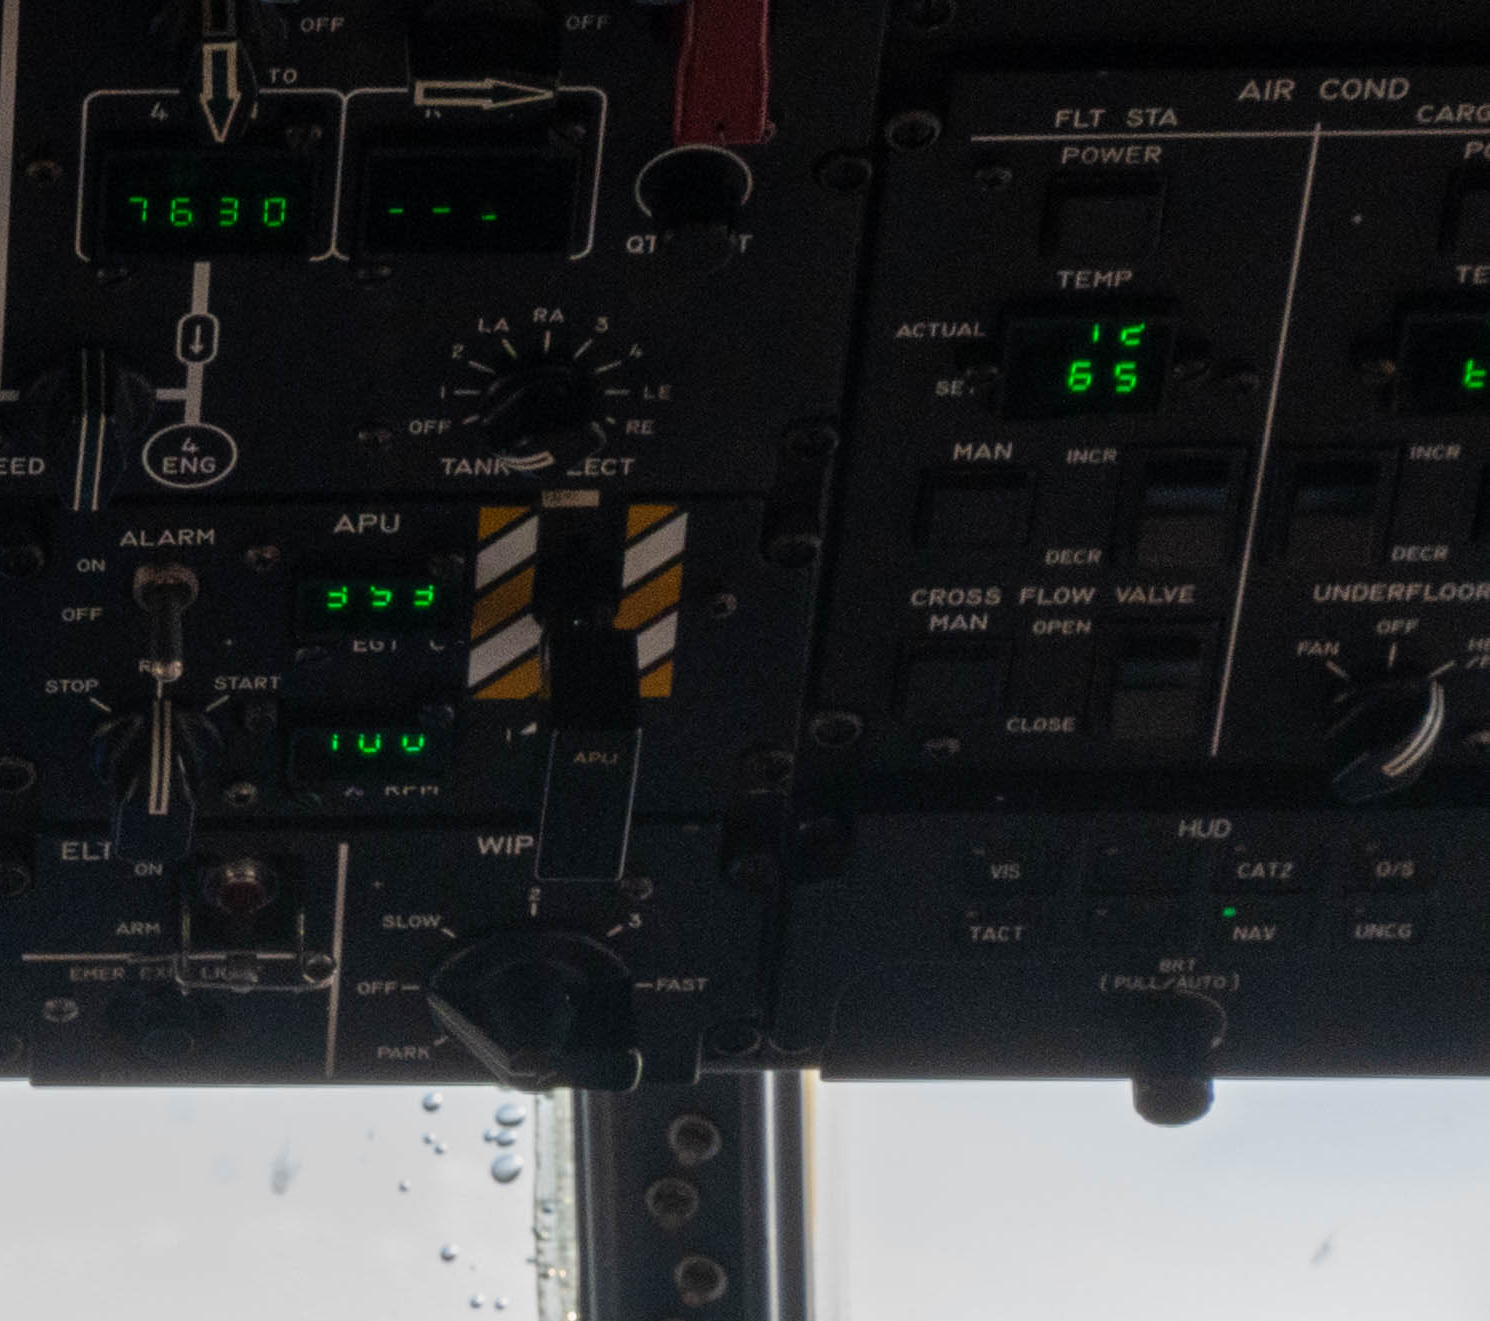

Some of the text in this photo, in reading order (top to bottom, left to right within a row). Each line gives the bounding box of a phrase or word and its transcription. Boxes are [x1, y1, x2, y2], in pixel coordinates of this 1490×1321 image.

[300, 16, 344, 33] OFF
[565, 15, 609, 31] OFF
[1237, 76, 1410, 101] AIR COND
[1054, 107, 1179, 129] FLT STA
[1061, 145, 1163, 165] POWER
[129, 197, 287, 228] 7630
[1056, 268, 1132, 290] TEMP
[895, 321, 986, 339] ACTUAL
[408, 420, 451, 436] OFF
[953, 442, 1013, 461] MAN
[1066, 448, 1118, 465] INCR
[1409, 443, 1462, 461] INCR
[162, 457, 217, 476] ENG
[333, 513, 402, 535] APU
[119, 528, 216, 547] ALARM
[1045, 548, 1102, 565] DECR
[1391, 544, 1450, 562] DECR
[910, 584, 1196, 607] CROSS FLOW VALVE
[1313, 582, 1490, 603] UNDERFLOOR
[61, 606, 103, 622] OFF
[929, 613, 989, 633] MAN
[1032, 618, 1092, 636] OPEN
[1375, 617, 1420, 635] OFF
[1296, 640, 1341, 657] FAN
[44, 678, 99, 695] STOP
[213, 674, 280, 691] START
[1005, 716, 1076, 734] CLOSE
[1178, 819, 1231, 839] HUD
[1237, 862, 1294, 880] CAT2
[115, 920, 161, 936] ARM
[382, 914, 441, 930] SLOW
[968, 925, 1024, 943] TACT
[1231, 925, 1276, 942] NAV
[69, 965, 126, 982] EMER
[357, 981, 398, 996] OFF
[657, 977, 708, 993] FAST
[378, 1045, 430, 1060] PARK
